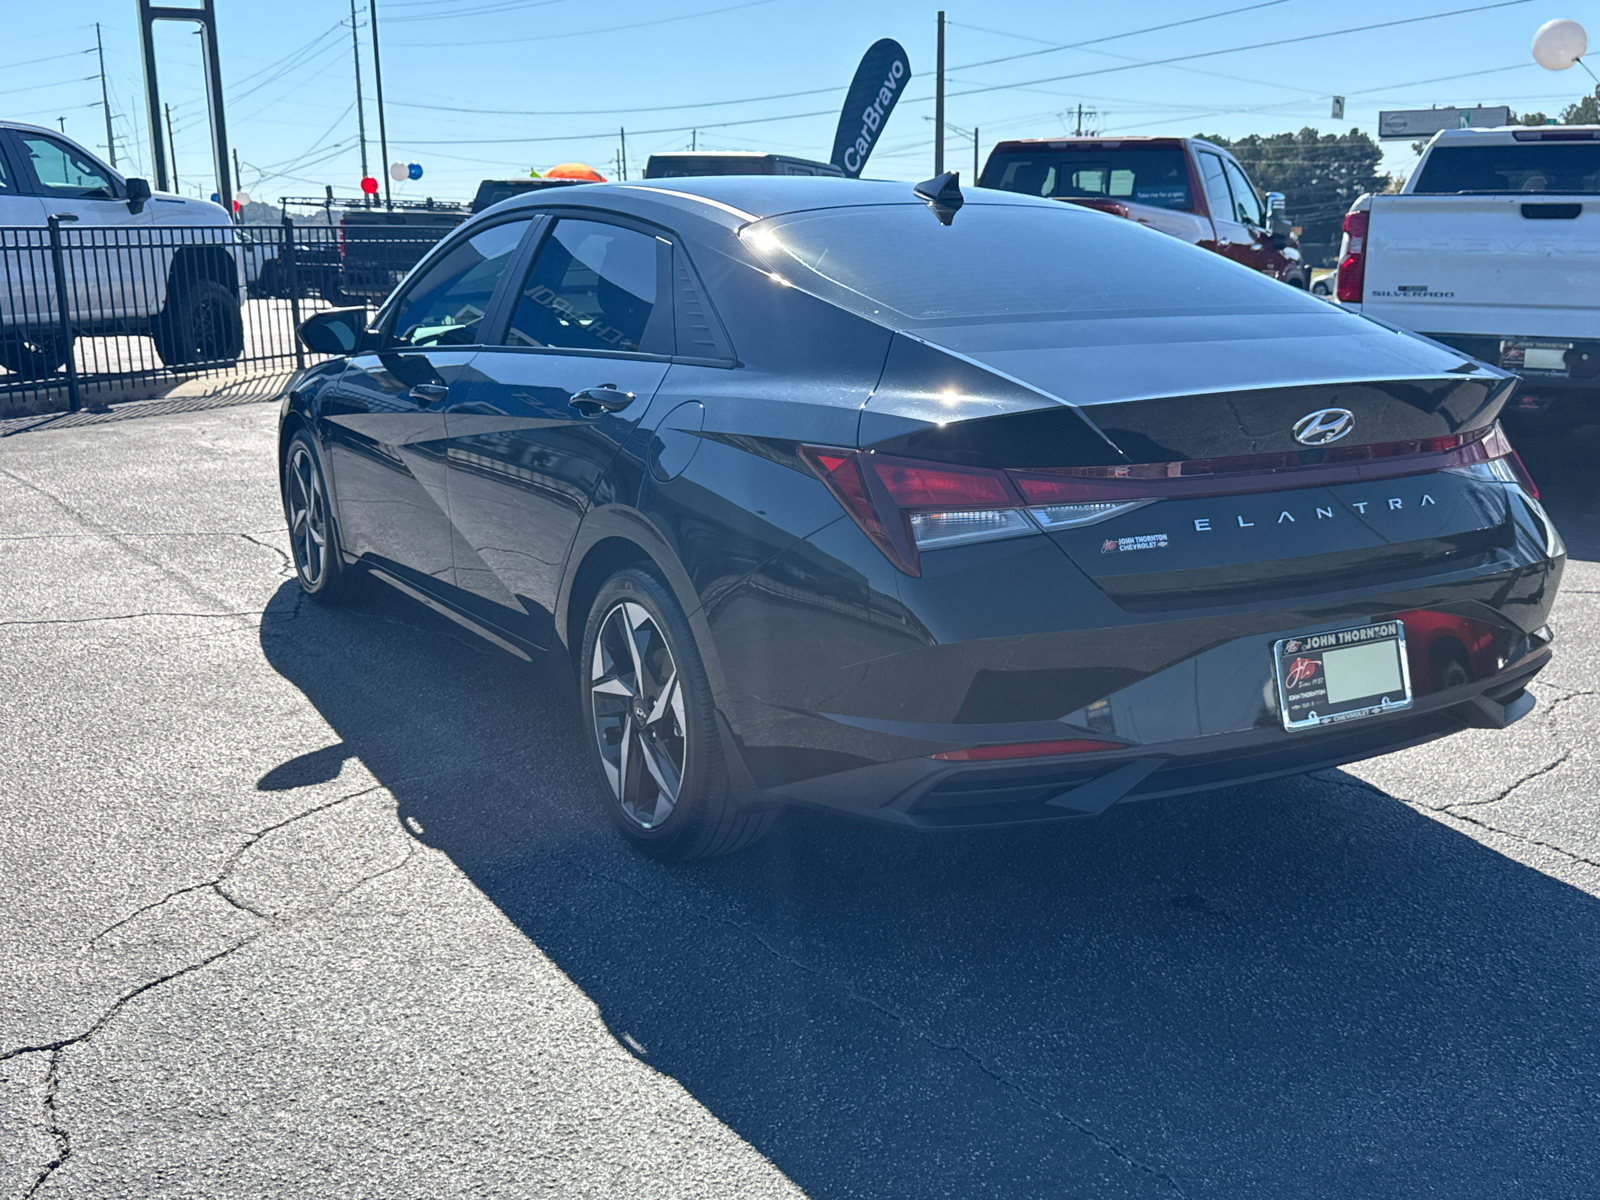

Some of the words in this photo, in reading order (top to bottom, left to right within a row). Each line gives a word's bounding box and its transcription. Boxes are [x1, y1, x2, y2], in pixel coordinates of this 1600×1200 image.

[844, 60, 904, 172] CarBravo
[1372, 290, 1454, 298] SILVERADO
[1194, 494, 1436, 532] ELANTRA
[1118, 537, 1135, 545] JOHN
[1135, 534, 1168, 543] THORNTON
[1119, 541, 1156, 551] CHEVROLET
[1306, 634, 1336, 650] JOHN
[1338, 623, 1397, 644] THORNTON
[1288, 693, 1301, 702] JOHN
[1300, 688, 1326, 699] THORNTON
[1333, 709, 1370, 722] CHEVROLET
